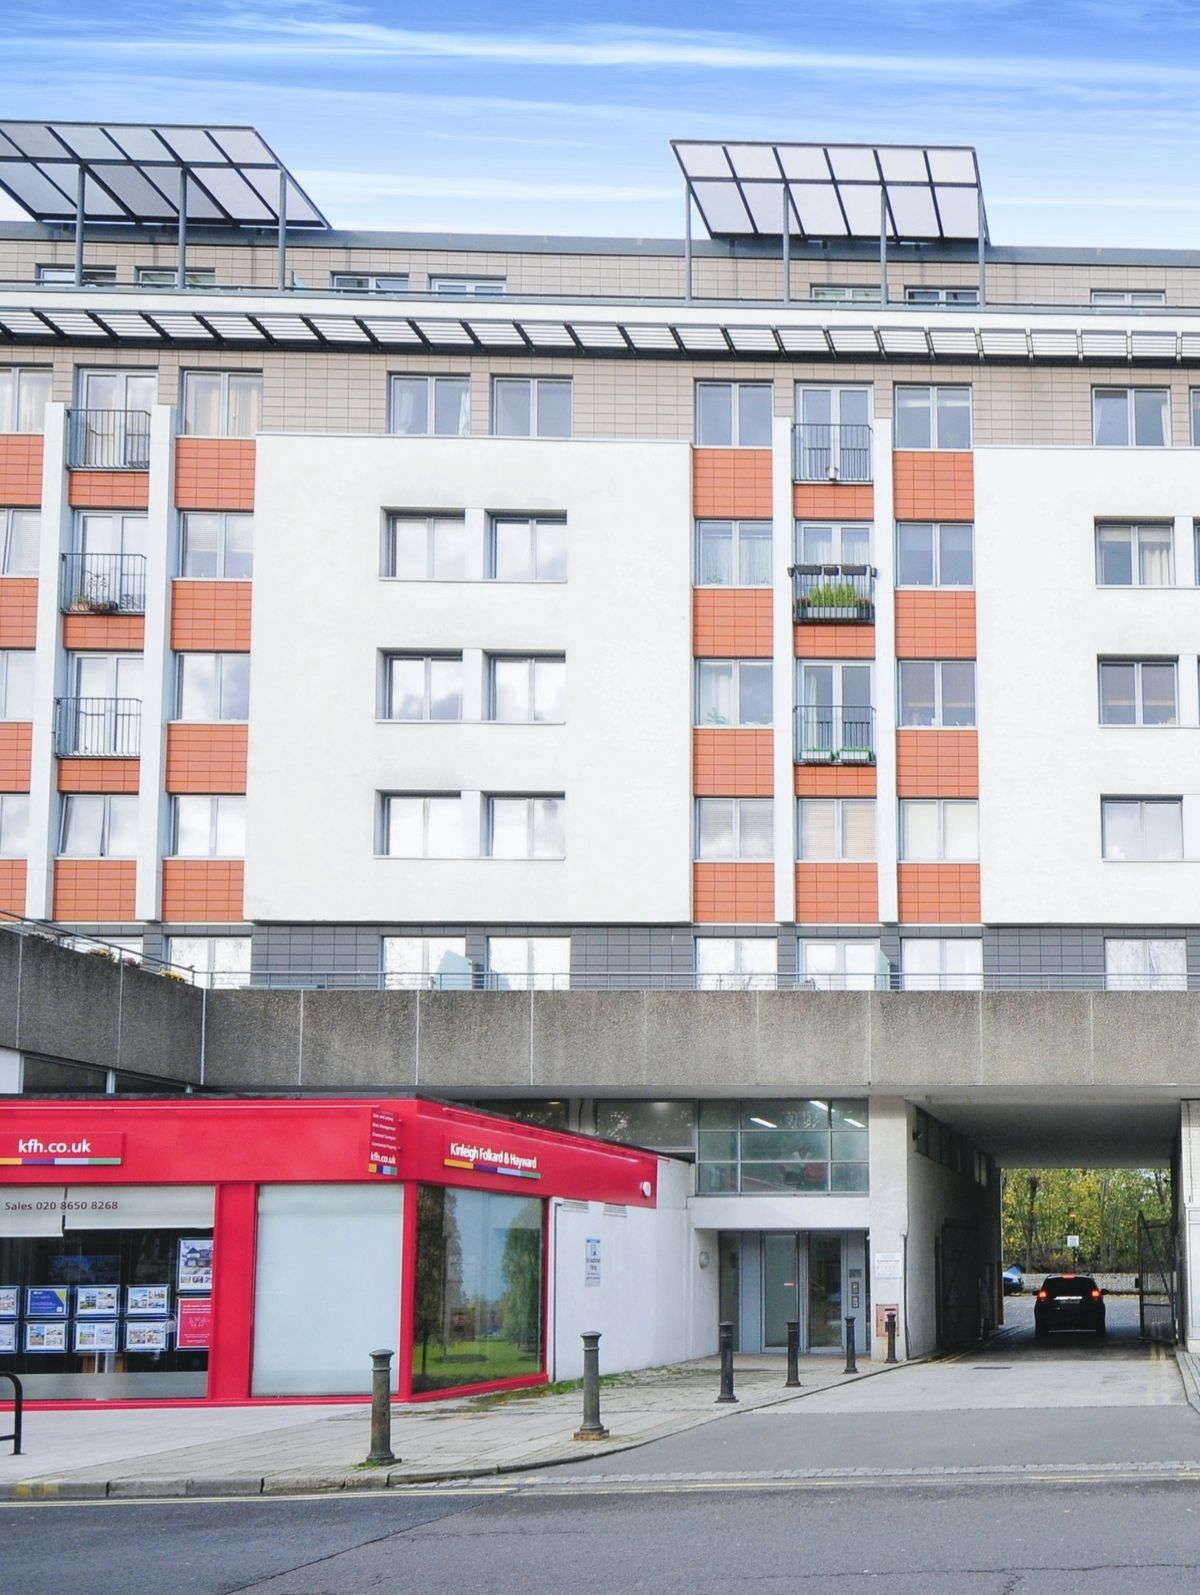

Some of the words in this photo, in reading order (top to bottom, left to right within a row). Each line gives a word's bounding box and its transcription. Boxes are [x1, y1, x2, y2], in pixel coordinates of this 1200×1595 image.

[18, 1138, 91, 1153] kfh.co.uk
[450, 1142, 478, 1161] Kinleigh
[479, 1147, 503, 1164] Folkard
[504, 1151, 510, 1164] &
[510, 1153, 537, 1169] Hayward
[5, 1201, 32, 1211] Sales
[36, 1201, 57, 1210] 020
[60, 1201, 88, 1210] 8650
[91, 1201, 119, 1210] 8268
